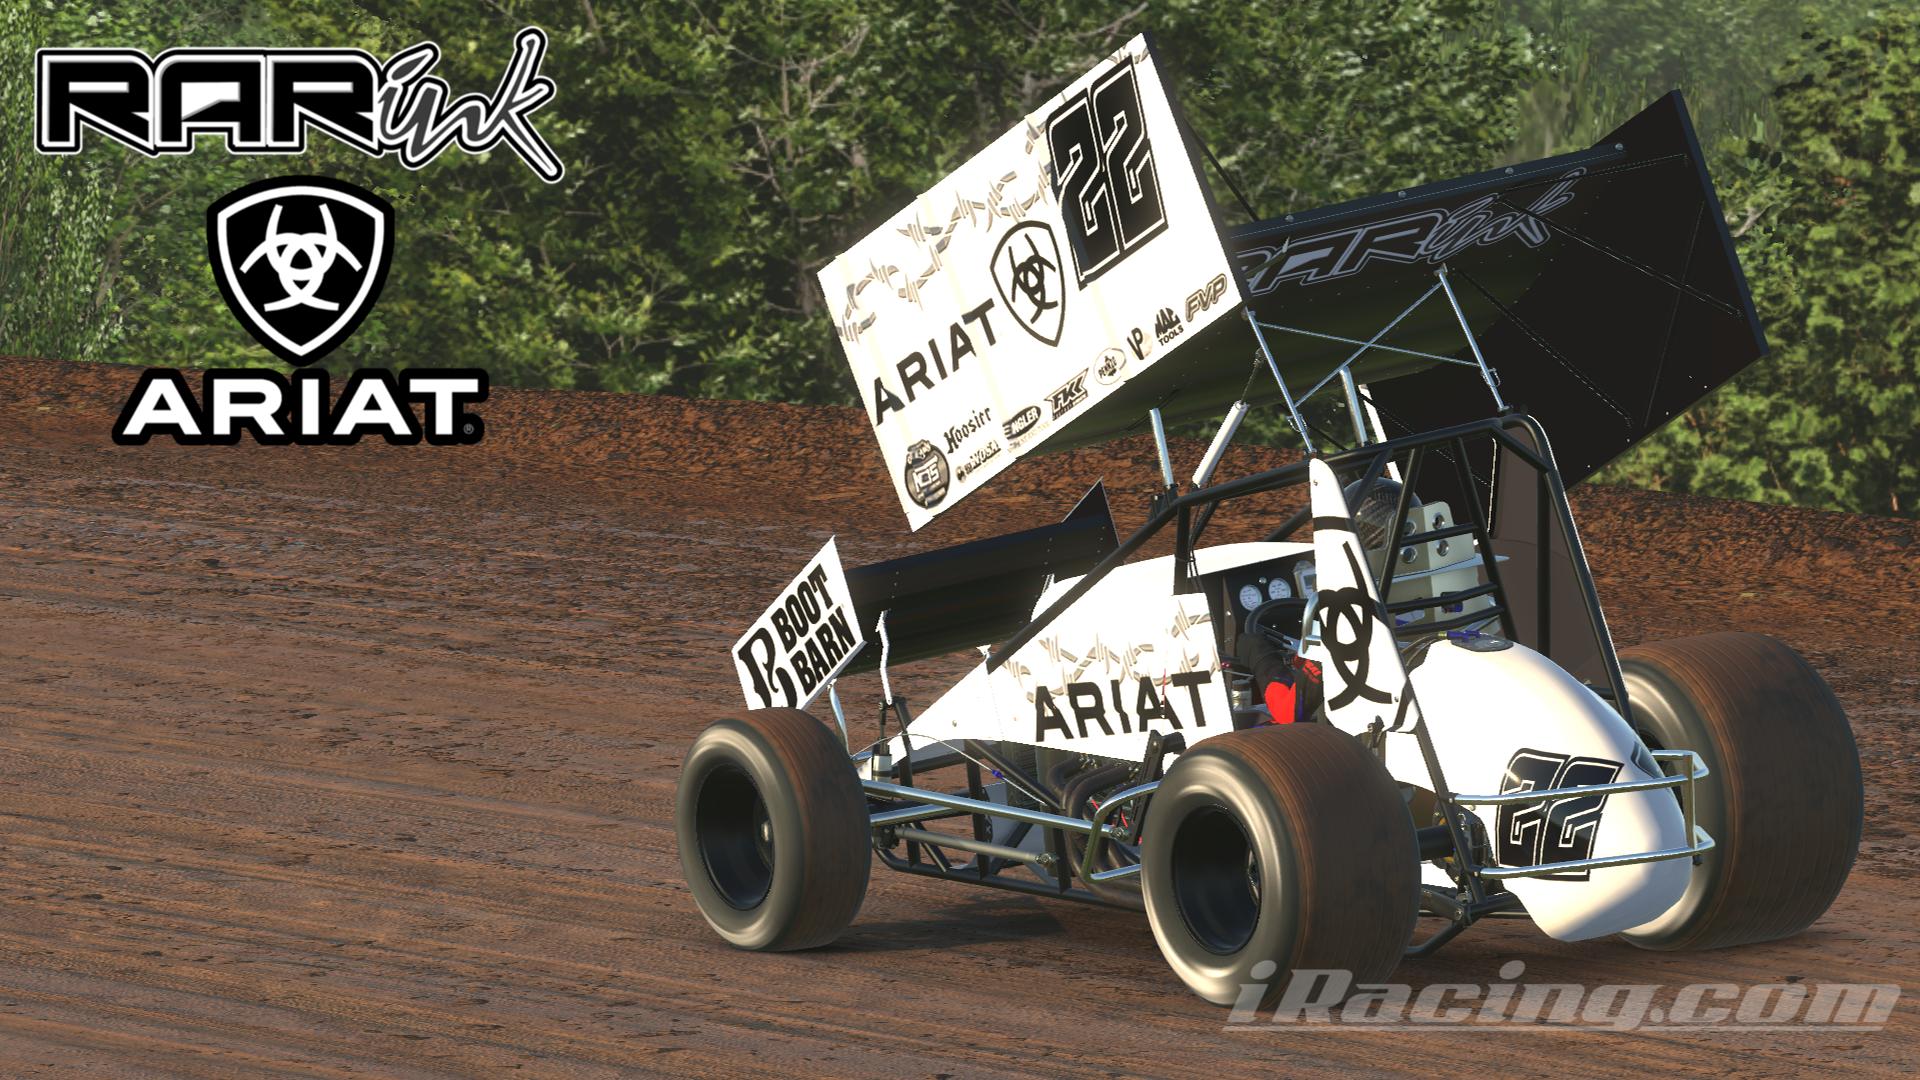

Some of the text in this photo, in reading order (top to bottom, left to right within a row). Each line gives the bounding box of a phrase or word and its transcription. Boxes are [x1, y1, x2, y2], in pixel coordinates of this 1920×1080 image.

[1046, 53, 1169, 290] 22
[1158, 324, 1184, 346] TOOLS
[1185, 273, 1227, 322] FVP
[874, 297, 996, 426] ARIAT
[770, 563, 834, 654] BOOT
[789, 605, 857, 697] BARN
[1034, 670, 1212, 743] ARIAT
[1494, 747, 1625, 882] 22
